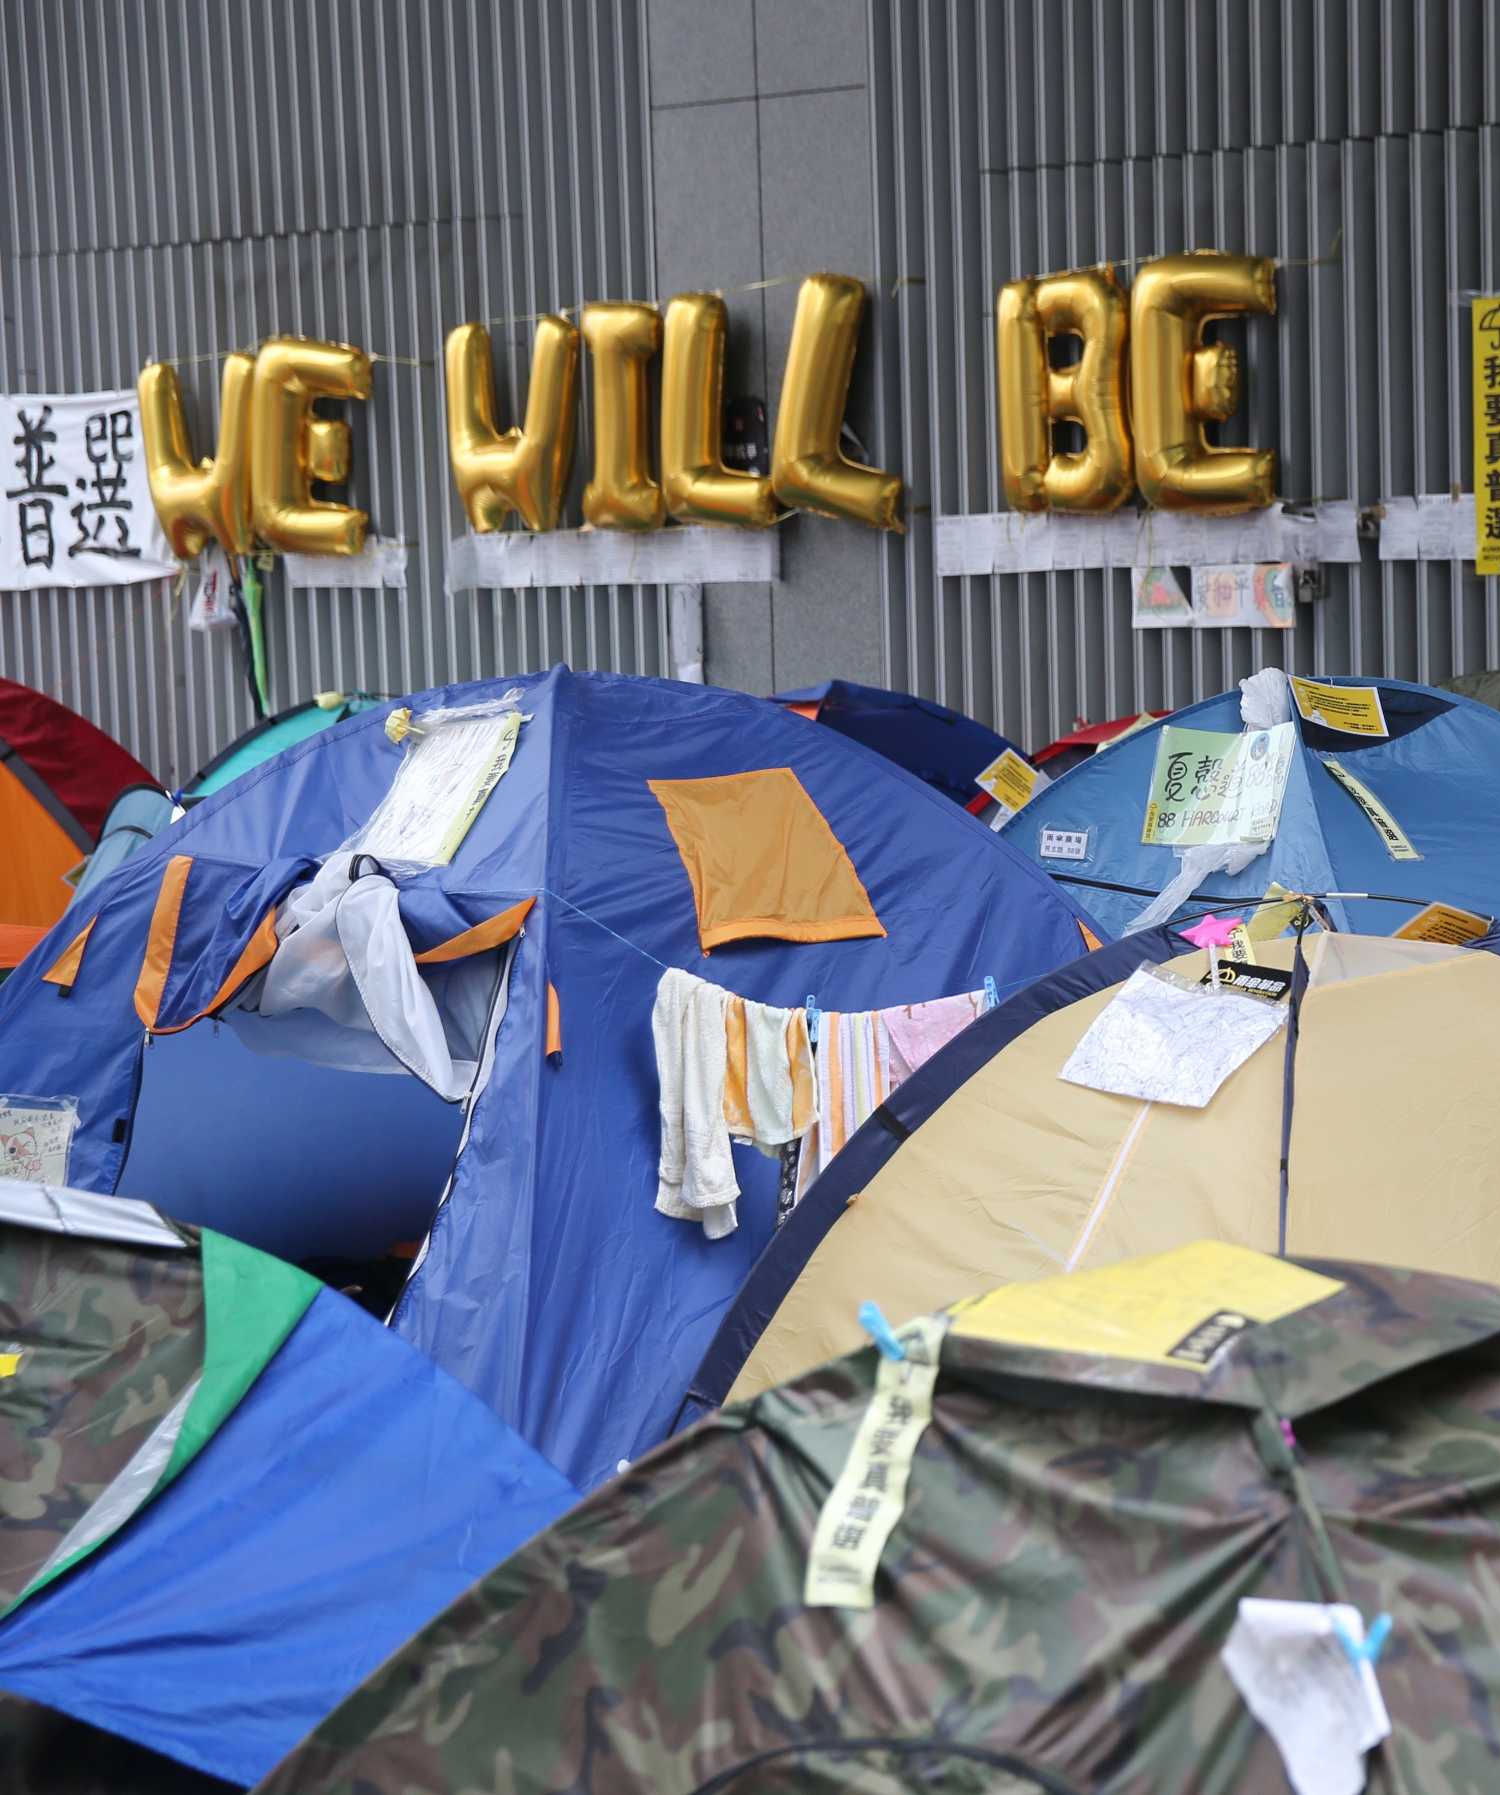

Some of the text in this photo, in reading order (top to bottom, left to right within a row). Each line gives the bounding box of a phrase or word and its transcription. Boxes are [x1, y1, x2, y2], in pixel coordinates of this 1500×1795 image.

[6, 405, 141, 570] 普選
[138, 334, 372, 561] WE
[444, 272, 905, 535] WILL
[997, 250, 1278, 516] BE
